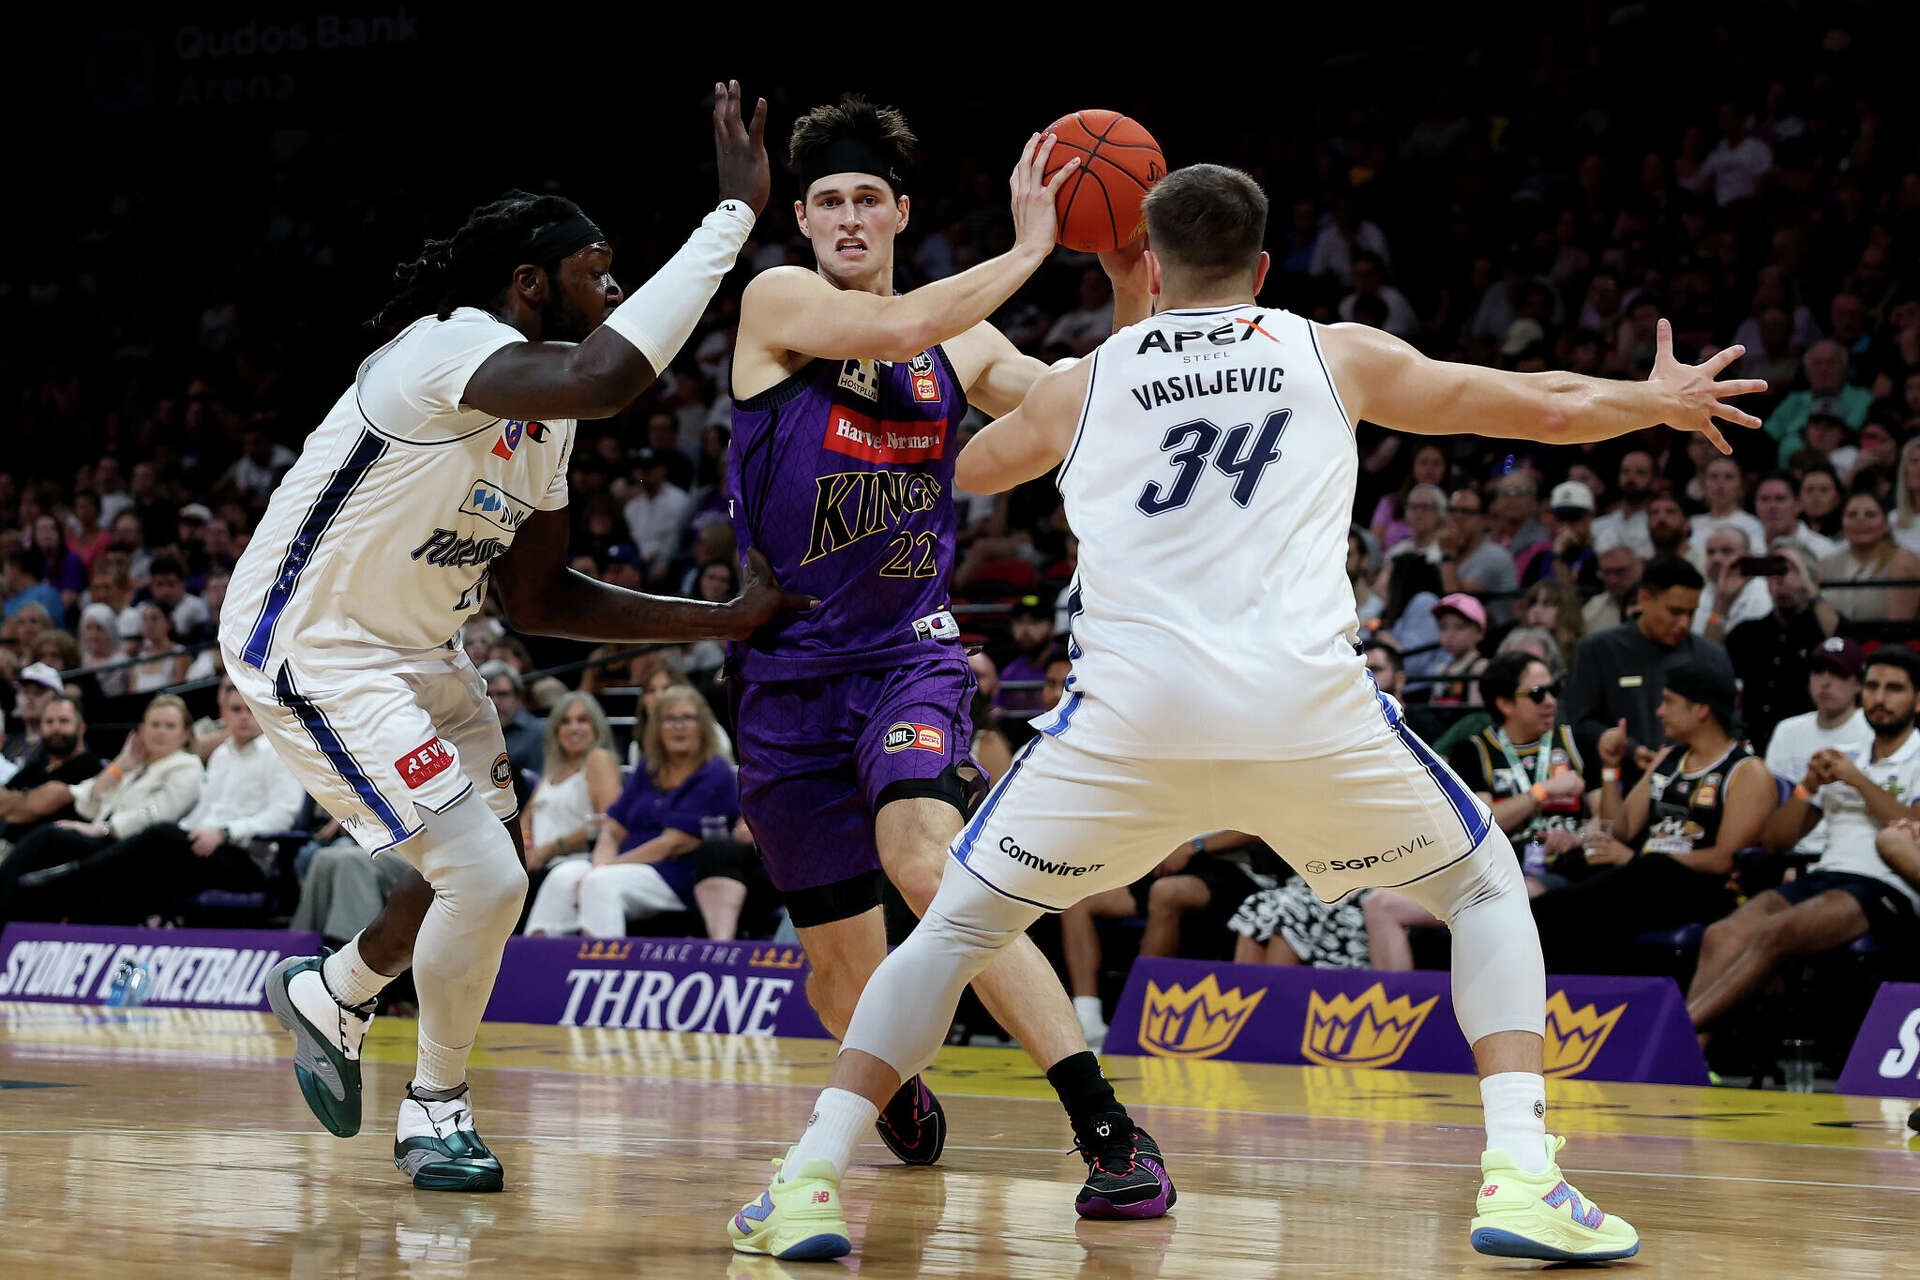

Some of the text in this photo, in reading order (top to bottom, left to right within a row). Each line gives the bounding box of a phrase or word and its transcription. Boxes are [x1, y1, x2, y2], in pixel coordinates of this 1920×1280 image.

[175, 3, 419, 61] Qudos Bank
[175, 72, 296, 108] Arena
[1136, 314, 1283, 355] APEX
[1183, 351, 1231, 364] STEEL
[840, 377, 878, 400] HOSTPLUS
[1131, 366, 1285, 411] VASILJEVIC
[1135, 408, 1292, 518] 34
[800, 470, 941, 566] KINGS
[879, 530, 938, 578] 22
[888, 730, 908, 746] NBL
[0, 940, 115, 998] SYDNEY
[640, 942, 742, 965] TAKE THE
[558, 968, 794, 1037] THRONE
